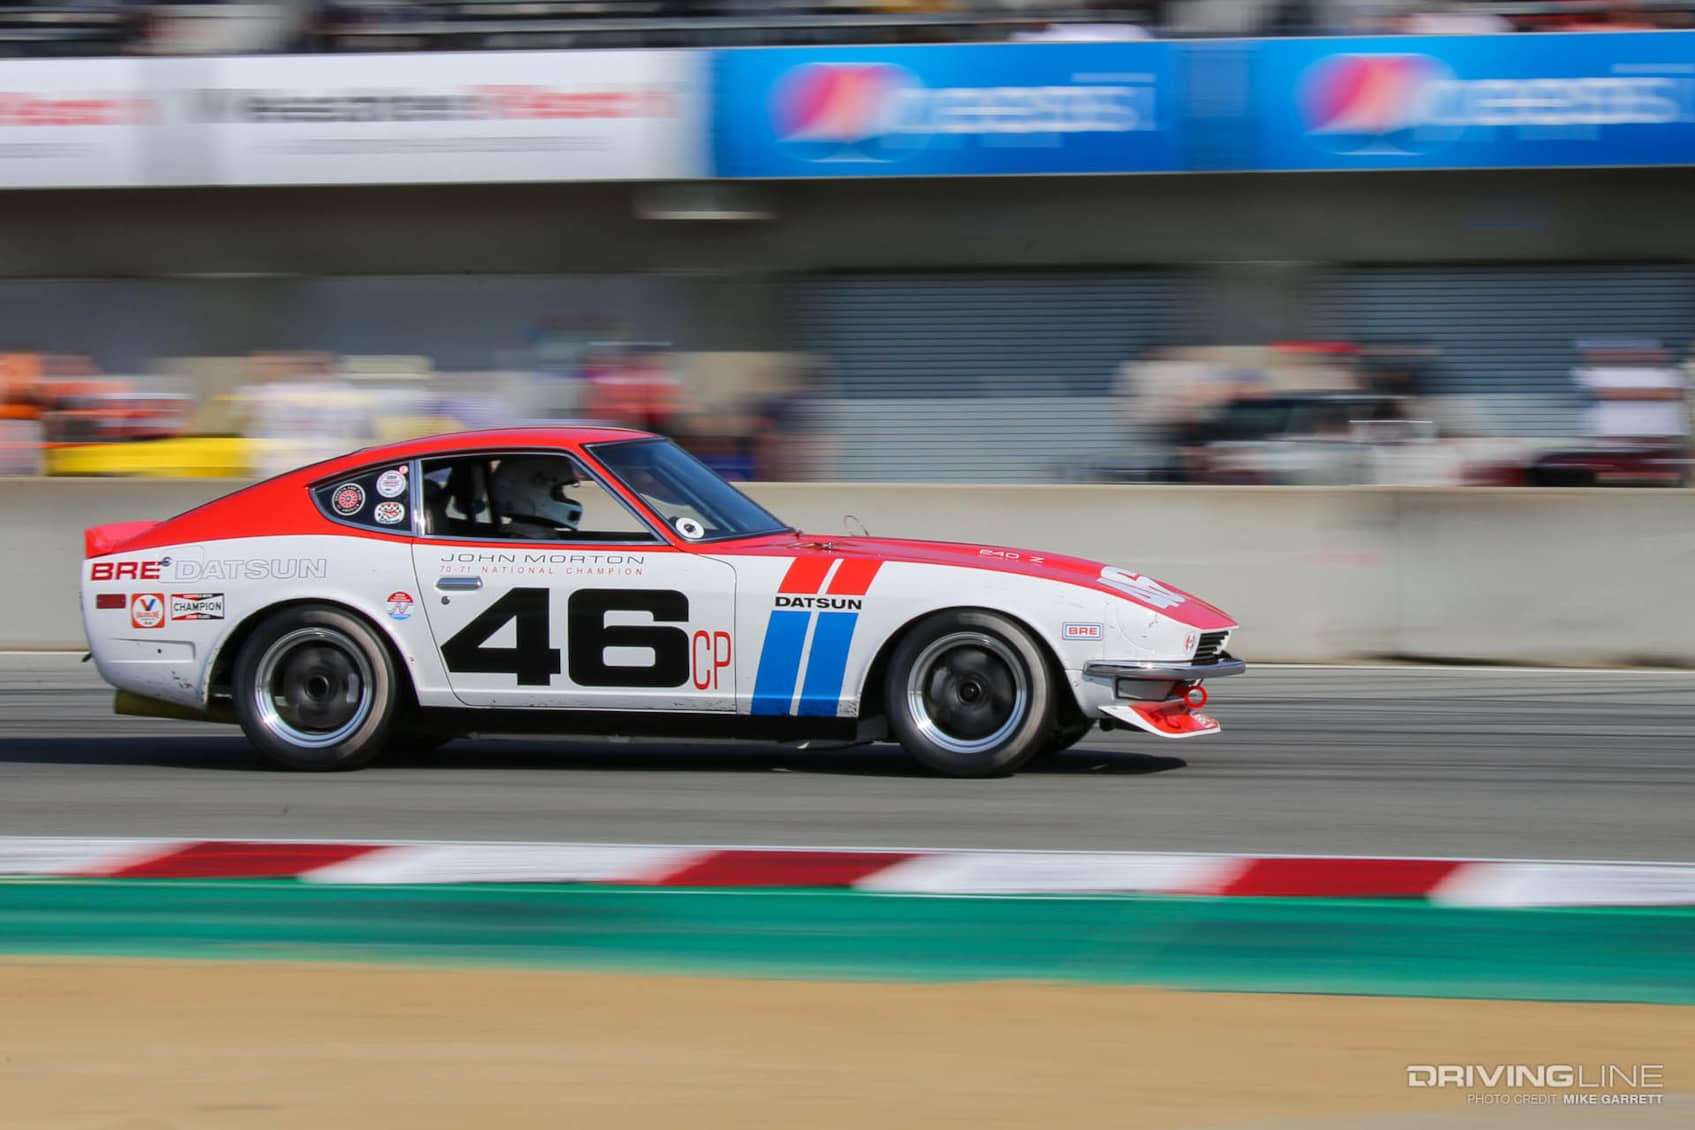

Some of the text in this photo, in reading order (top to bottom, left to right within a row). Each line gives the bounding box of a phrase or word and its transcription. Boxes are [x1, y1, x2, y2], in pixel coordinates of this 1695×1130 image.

[440, 553, 645, 565] JOHN MORTON
[90, 558, 327, 581] BRE DATSUN
[481, 566, 554, 575] NATIONAL
[566, 567, 643, 576] CHAMPION
[173, 602, 222, 612] CHAMPION
[774, 596, 863, 610] DATSUN
[1068, 626, 1098, 636] BRE
[440, 587, 732, 690] 46 CP
